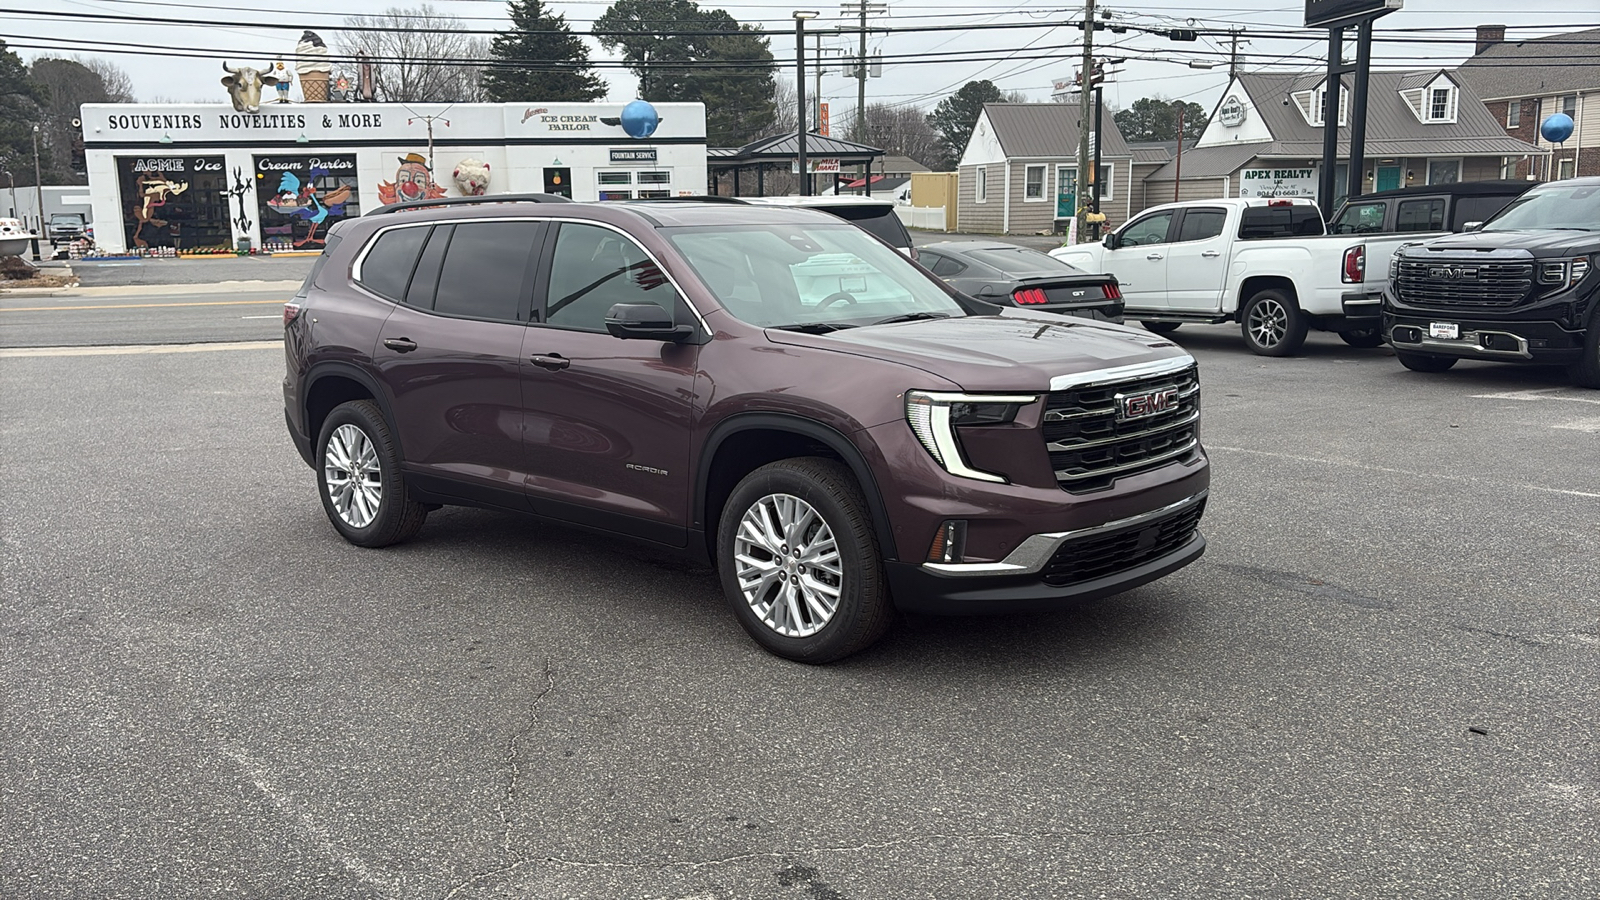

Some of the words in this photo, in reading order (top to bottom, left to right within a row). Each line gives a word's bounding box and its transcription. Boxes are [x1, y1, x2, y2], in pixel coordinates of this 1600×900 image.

[108, 114, 202, 130] SOUVENIRS
[219, 114, 306, 129] NOVELTIES
[322, 115, 333, 128] &
[338, 113, 382, 128] MORE
[541, 115, 558, 123] ICE
[560, 115, 598, 123] CREAM
[548, 123, 591, 131] PARLOR
[611, 151, 635, 159] FOUNTAIN
[635, 151, 656, 159] SERVICE
[134, 158, 185, 172] ACME
[193, 158, 223, 171] Ice
[258, 158, 303, 171] Cream
[308, 157, 354, 170] Parlor
[1244, 170, 1271, 180] APEX
[1273, 169, 1313, 179] REALTY
[1429, 267, 1478, 279] GMC
[1126, 390, 1179, 417] GMC
[625, 463, 669, 476] ACADIA
